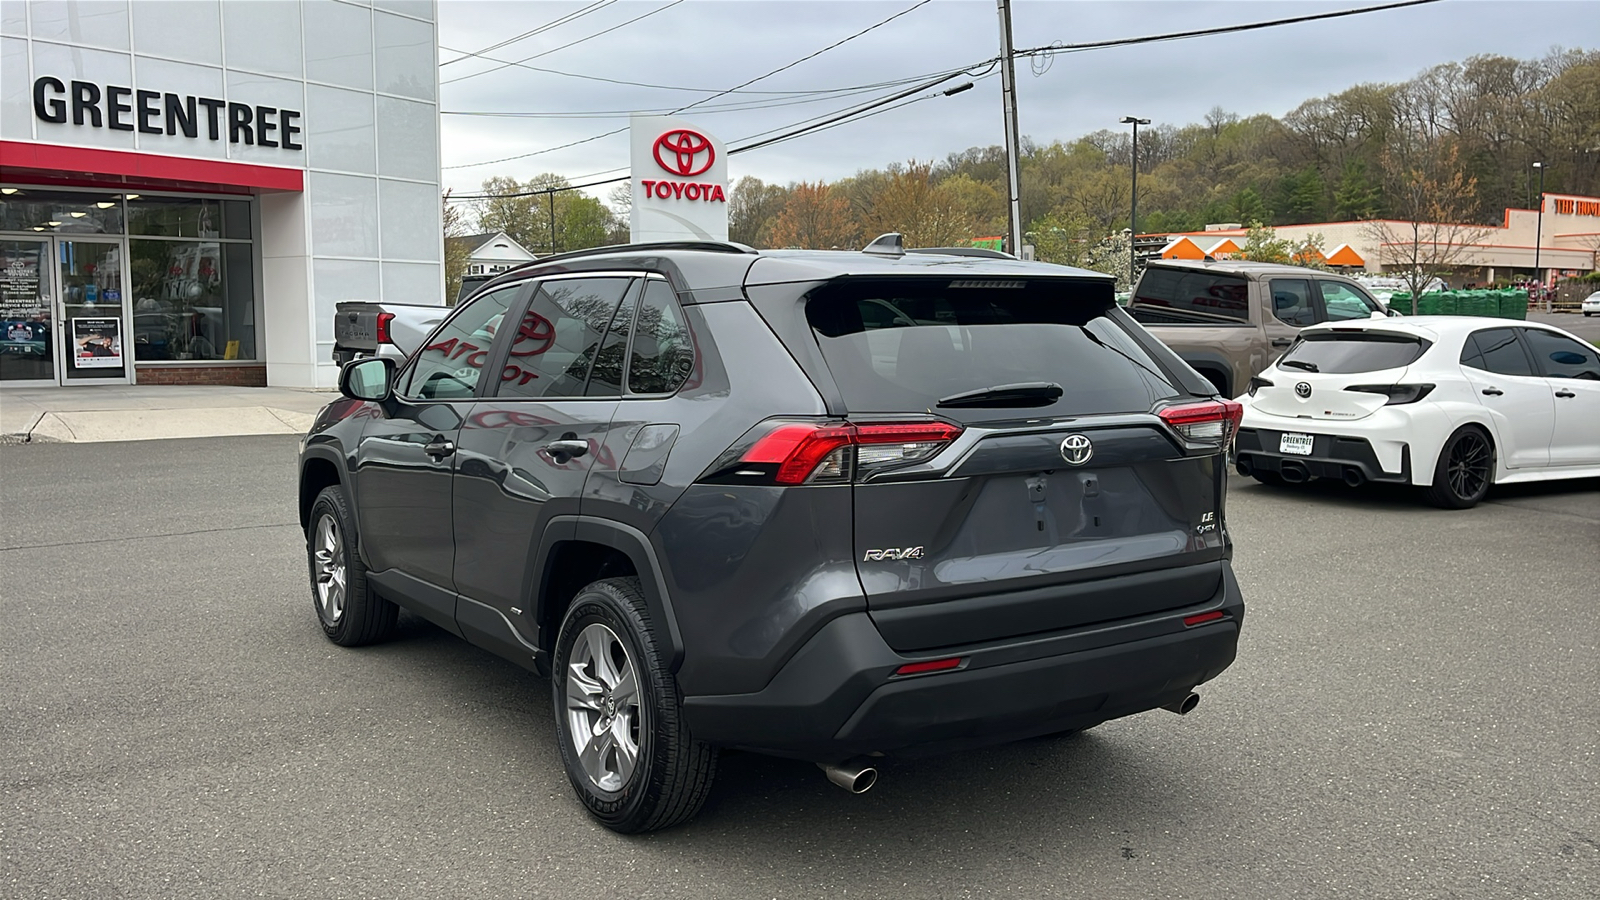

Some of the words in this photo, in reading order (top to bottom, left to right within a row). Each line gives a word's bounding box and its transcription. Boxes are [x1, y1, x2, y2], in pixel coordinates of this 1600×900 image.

[33, 76, 302, 150] GREENTREE
[641, 180, 726, 202] TOYOTA
[1555, 199, 1574, 214] THE
[1282, 436, 1312, 446] GREENTREE
[1202, 512, 1214, 522] LE
[863, 545, 925, 561] RAV4
